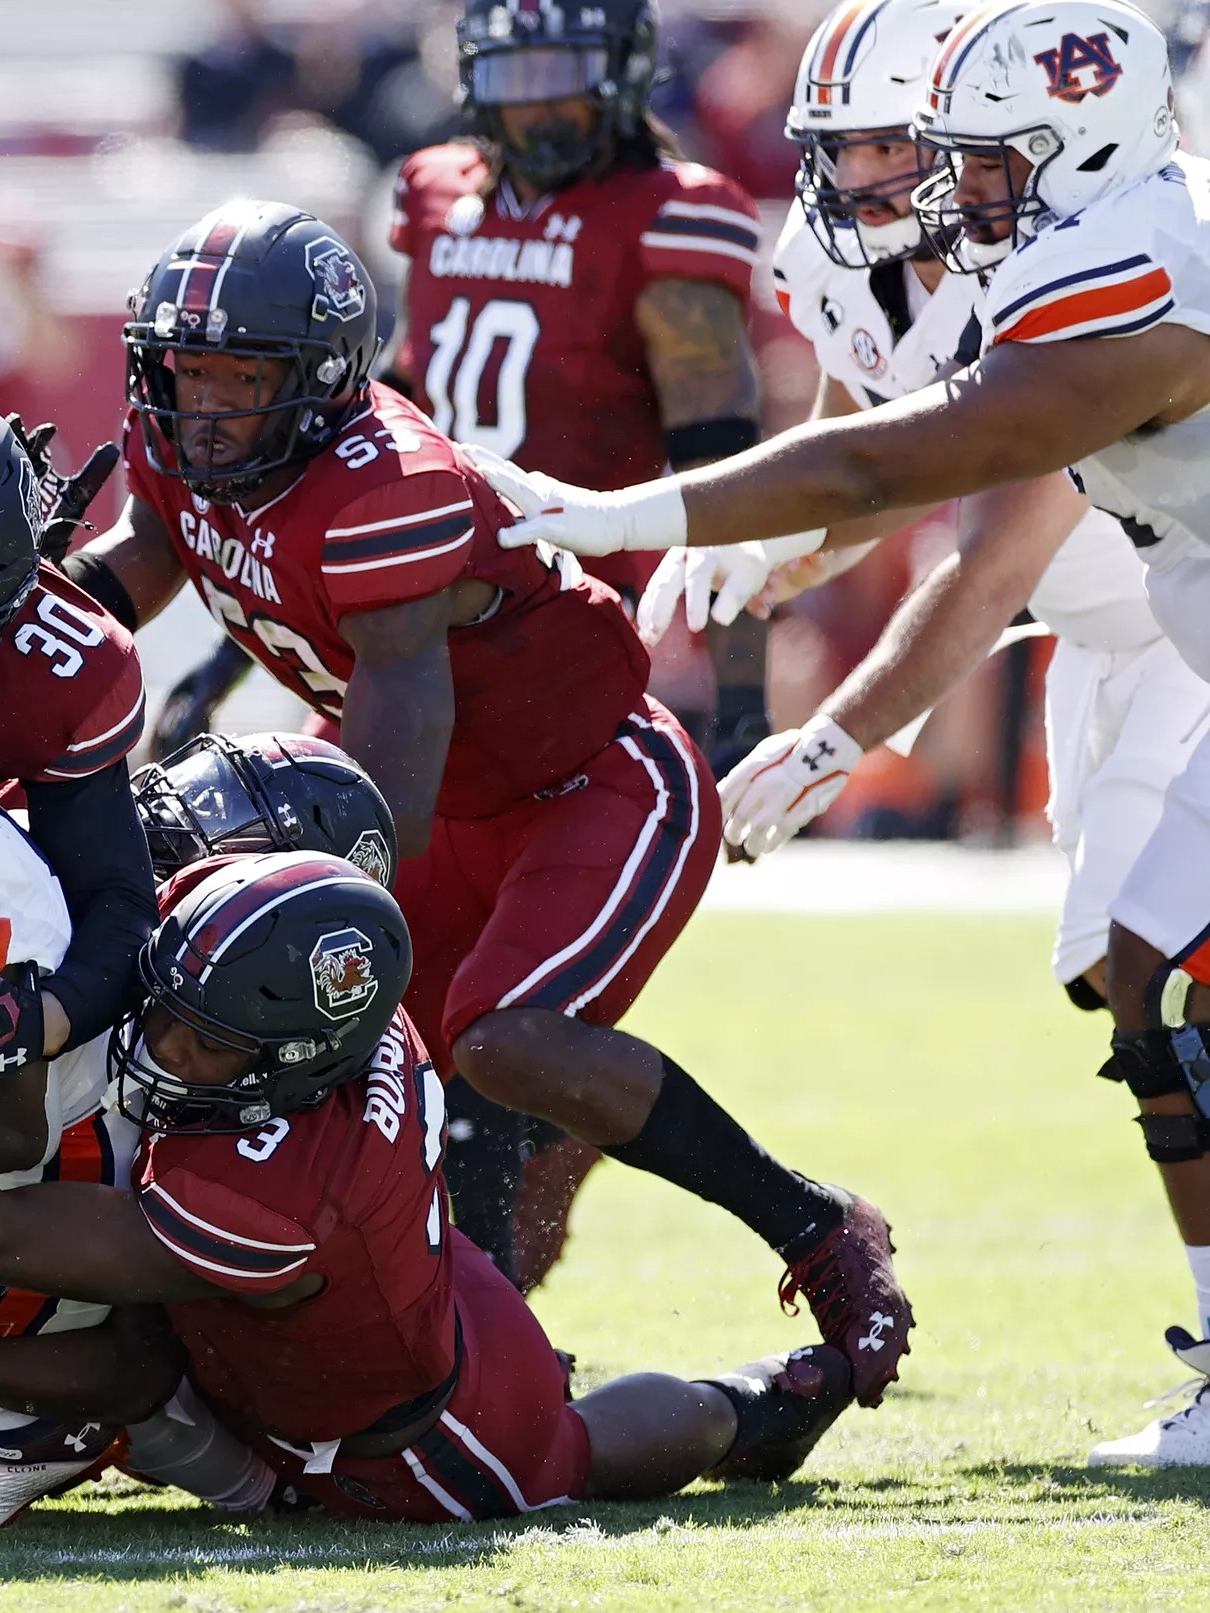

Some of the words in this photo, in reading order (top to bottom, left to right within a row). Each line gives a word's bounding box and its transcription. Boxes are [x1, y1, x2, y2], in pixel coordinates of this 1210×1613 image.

[429, 234, 574, 289] CAROLINA
[425, 297, 540, 462] 10
[14, 593, 106, 678] 30
[237, 1116, 291, 1162] 3
[7, 1464, 47, 1474] CLONE
